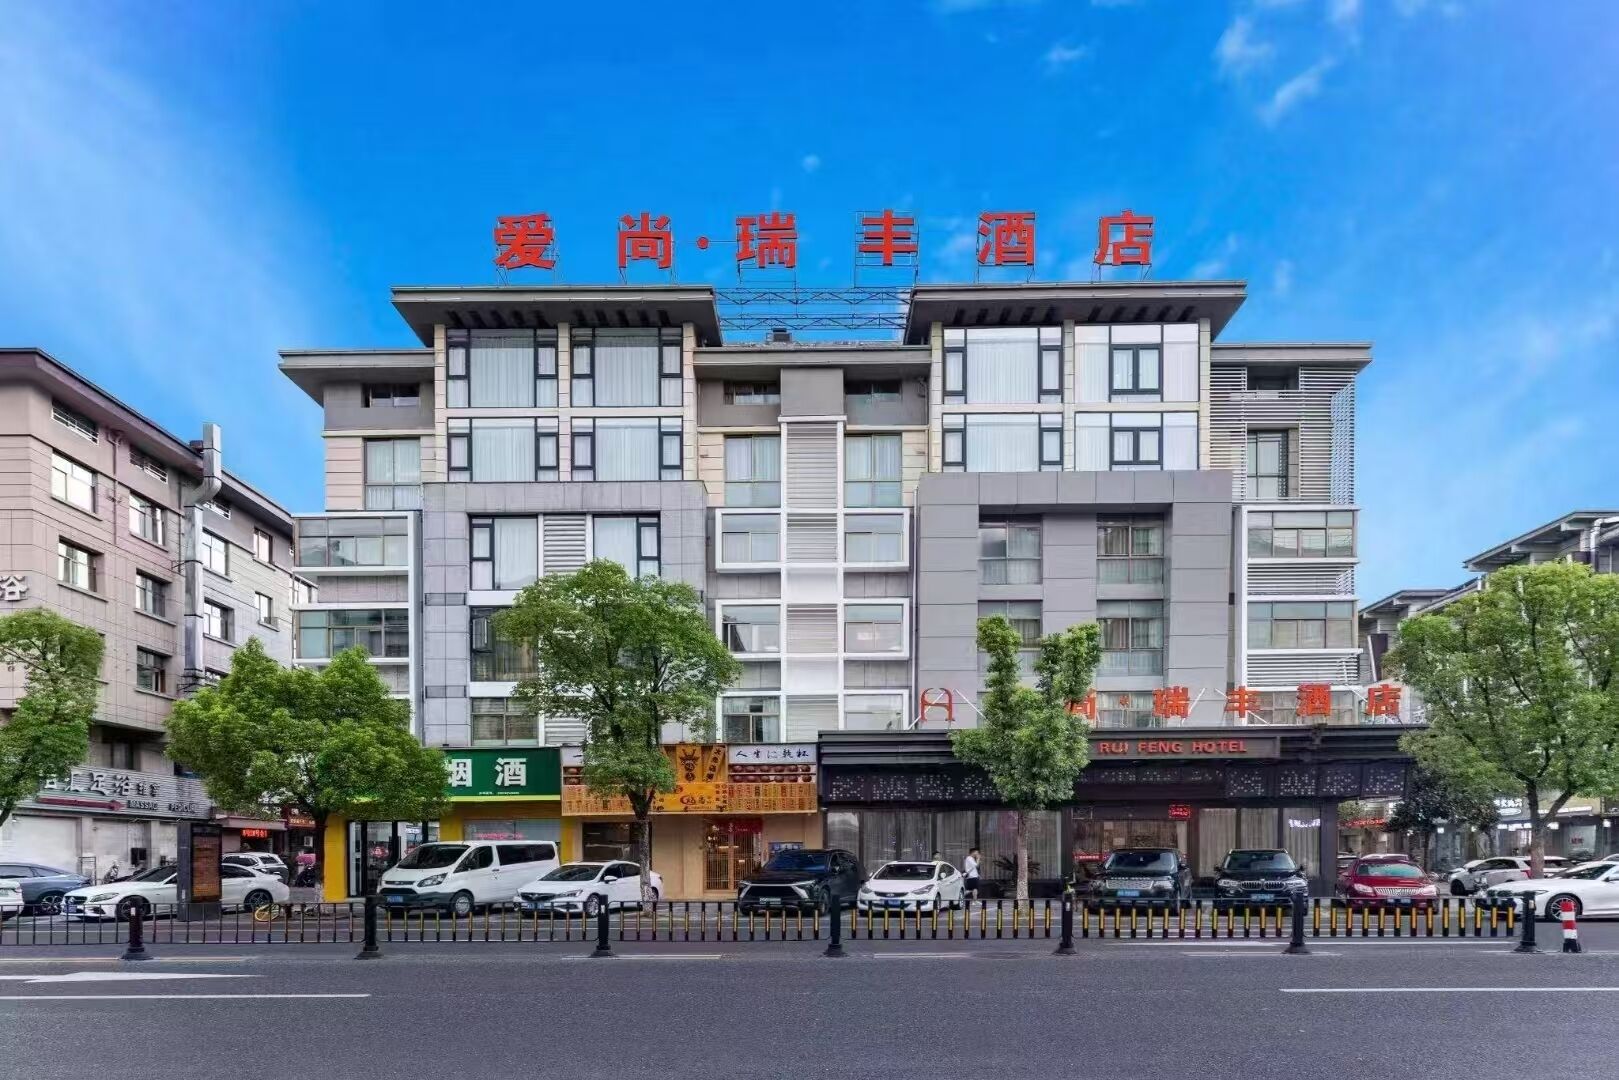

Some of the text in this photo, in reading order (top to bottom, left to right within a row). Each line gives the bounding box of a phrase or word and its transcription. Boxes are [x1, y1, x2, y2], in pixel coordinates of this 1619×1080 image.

[494, 210, 1153, 269] 爱尚·瑞丰酒店
[1099, 740, 1248, 753] RUI FENG HOTEL
[446, 757, 527, 788] 烟酒
